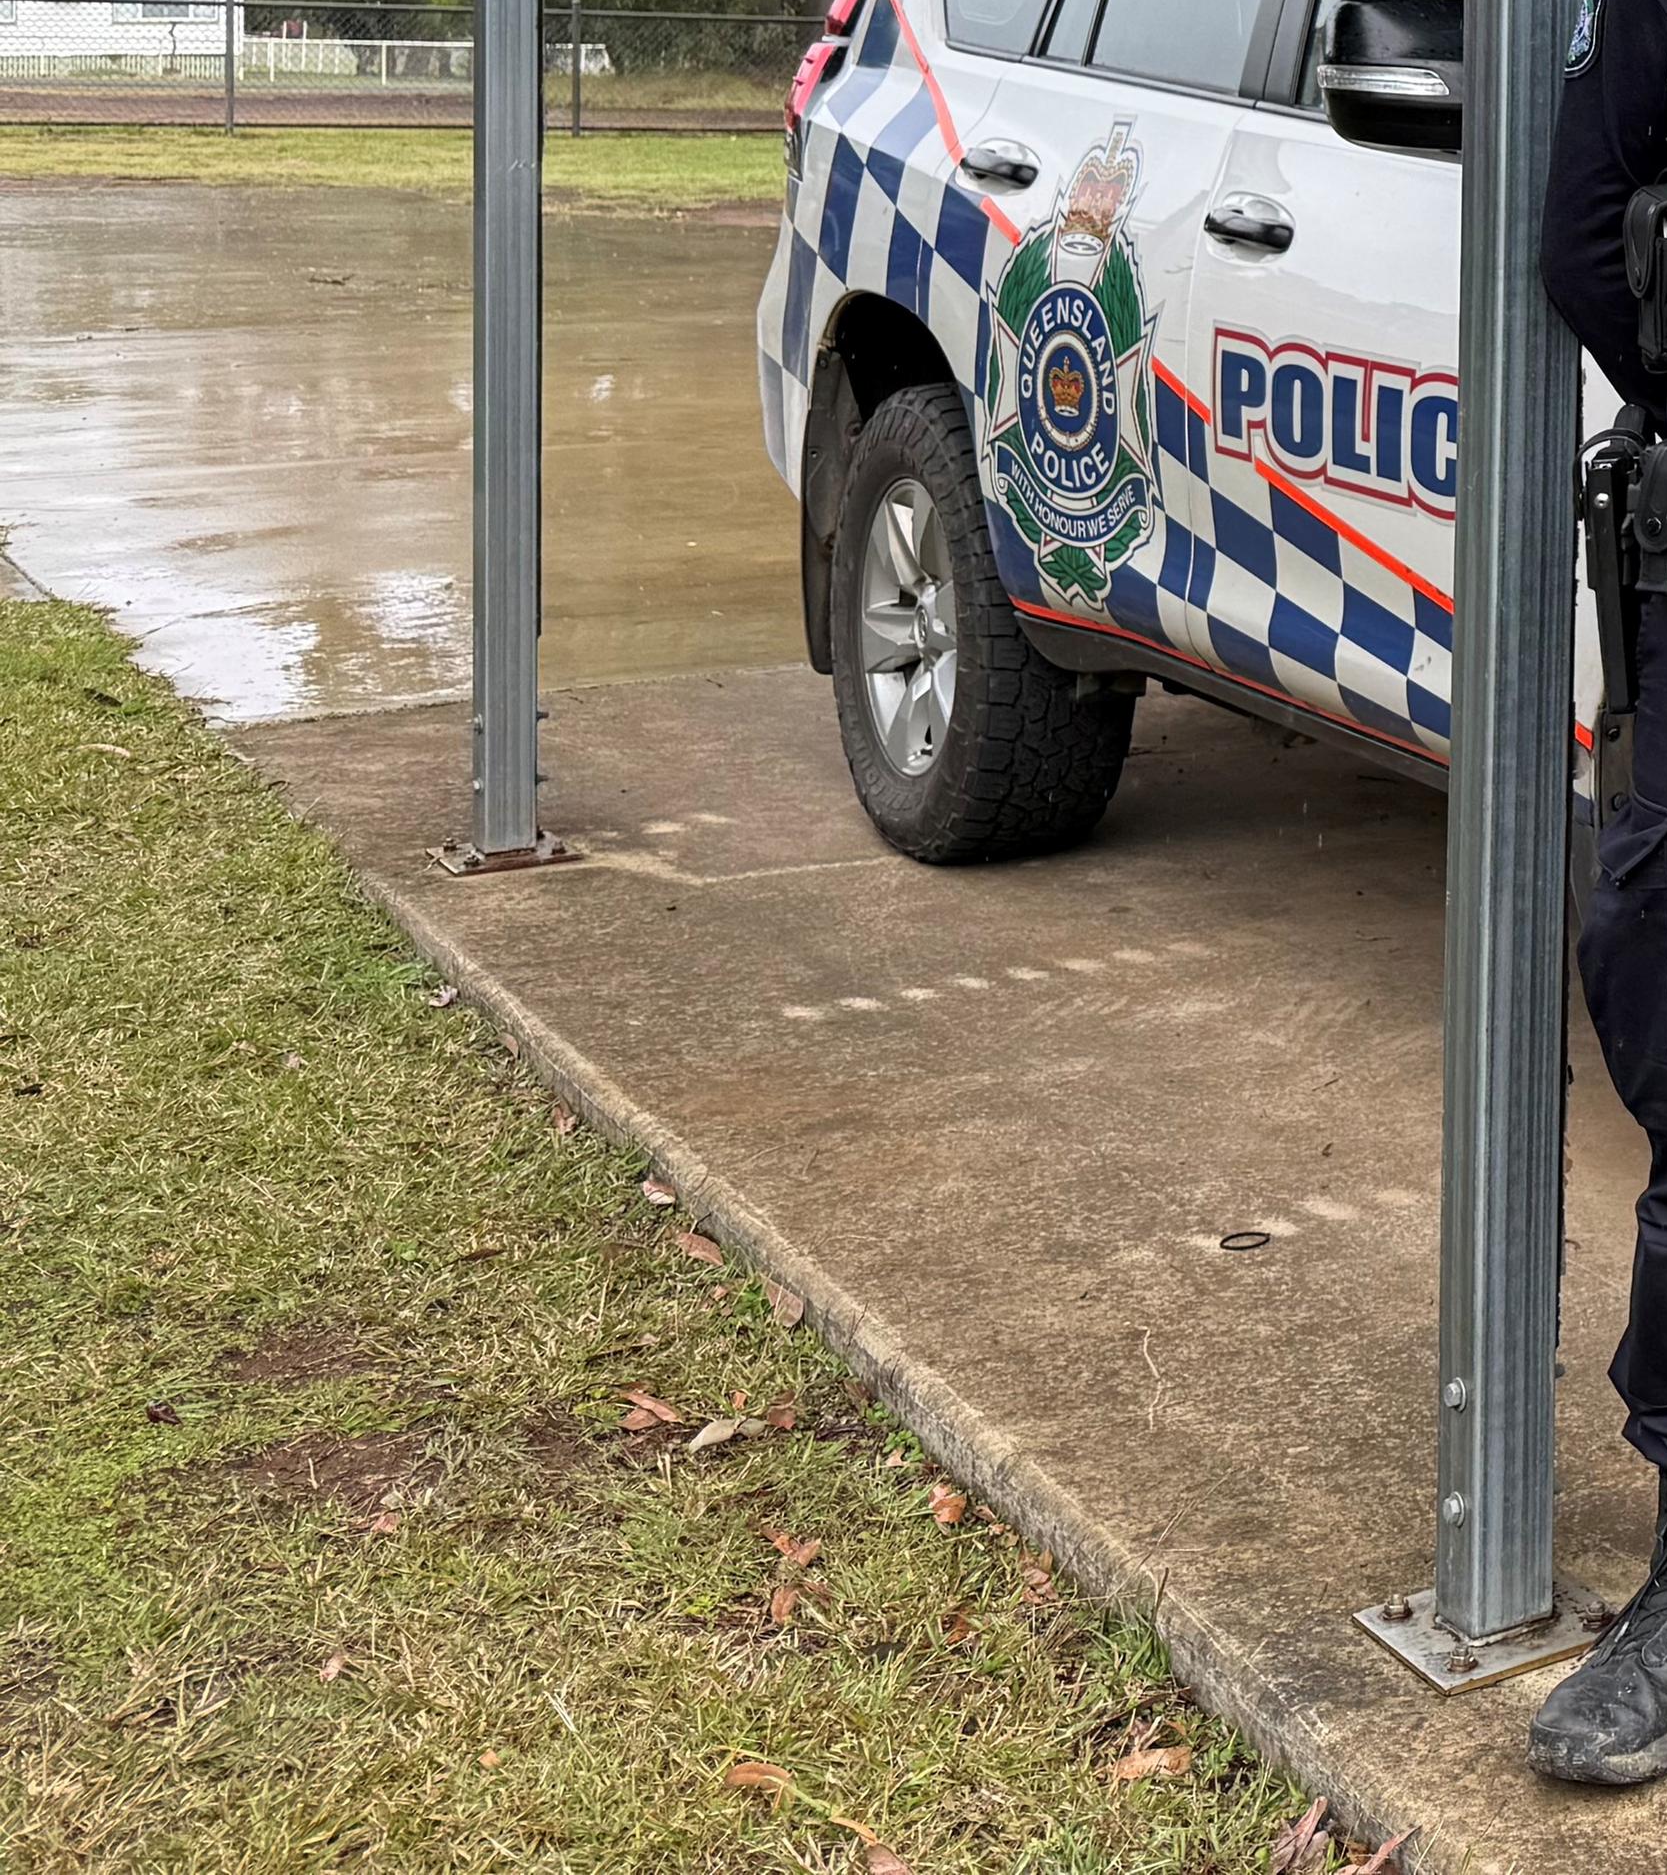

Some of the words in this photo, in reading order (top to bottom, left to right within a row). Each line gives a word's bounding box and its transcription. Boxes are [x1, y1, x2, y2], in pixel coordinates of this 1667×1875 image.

[1020, 296, 1116, 416] QUEENSLAND
[1030, 431, 1110, 489] POLICE
[1217, 335, 1460, 510] POLIC
[1011, 459, 1035, 505] WITH
[1034, 498, 1087, 539] HONOUR
[1087, 514, 1108, 538] WE
[1106, 484, 1136, 527] SERVE
